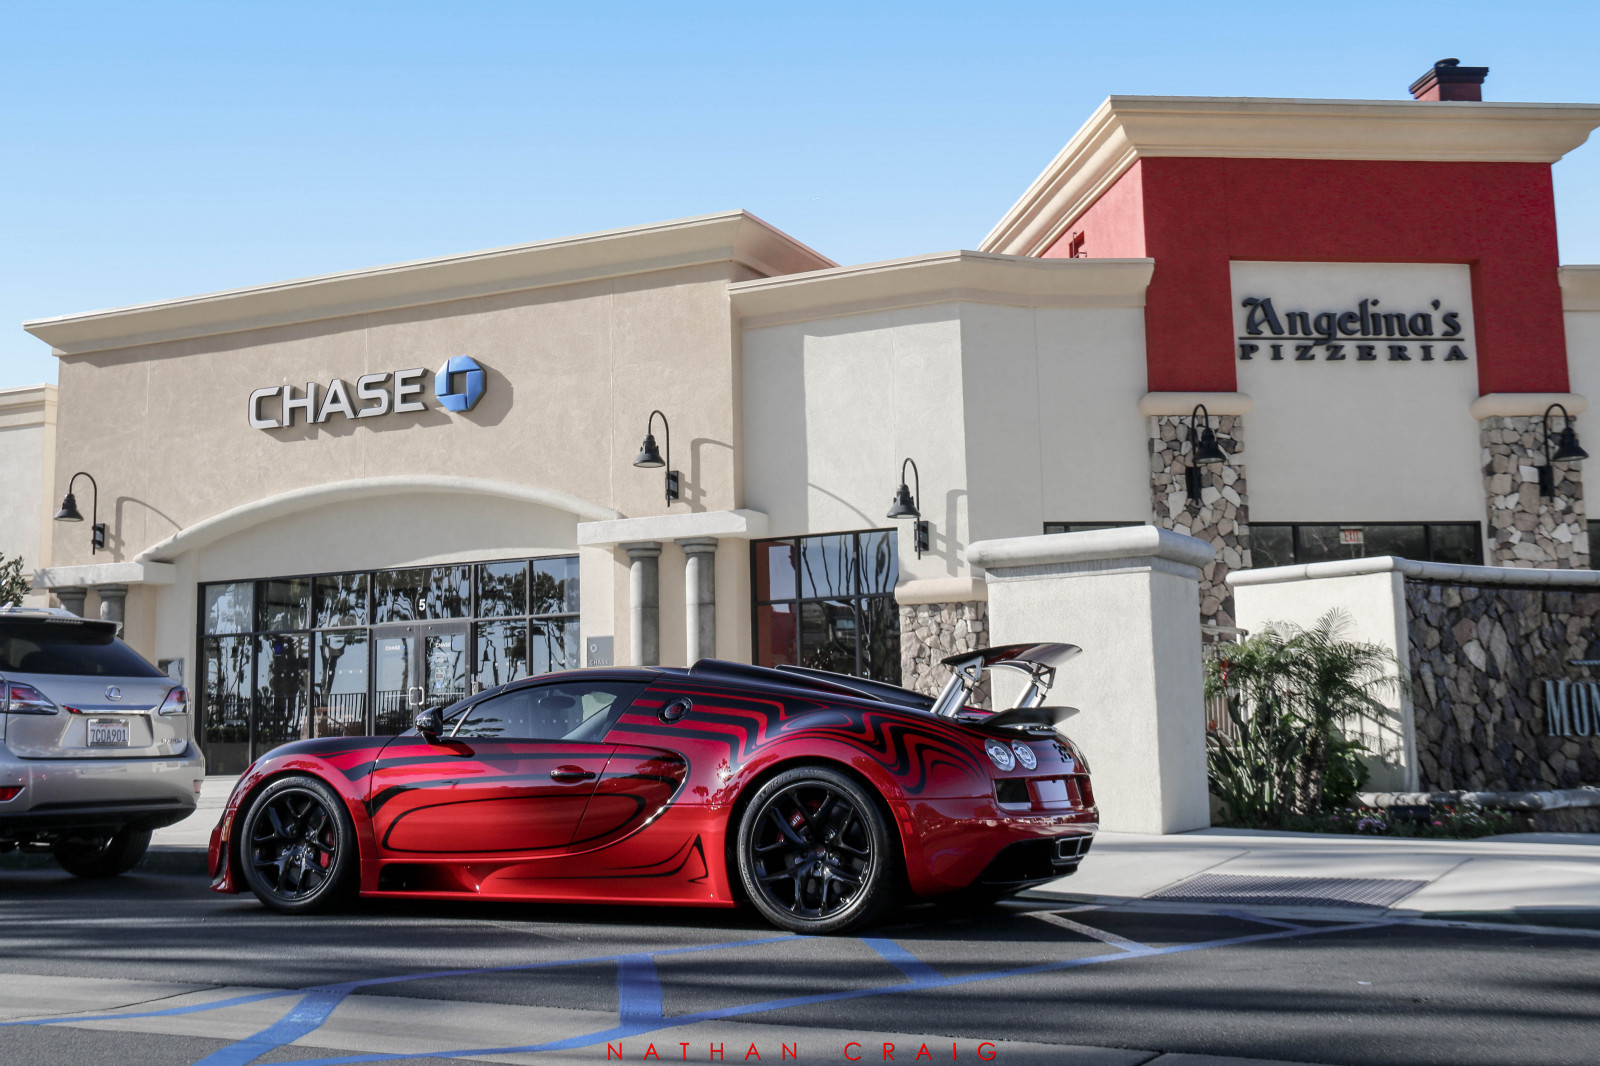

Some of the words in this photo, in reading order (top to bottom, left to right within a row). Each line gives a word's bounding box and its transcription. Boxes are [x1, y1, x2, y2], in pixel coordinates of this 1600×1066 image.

[1241, 297, 1462, 346] Angelina's
[1239, 343, 1468, 362] PIZZERIA
[248, 367, 429, 430] CHASE
[1344, 530, 1359, 543] EXIT
[418, 599, 426, 611] 5
